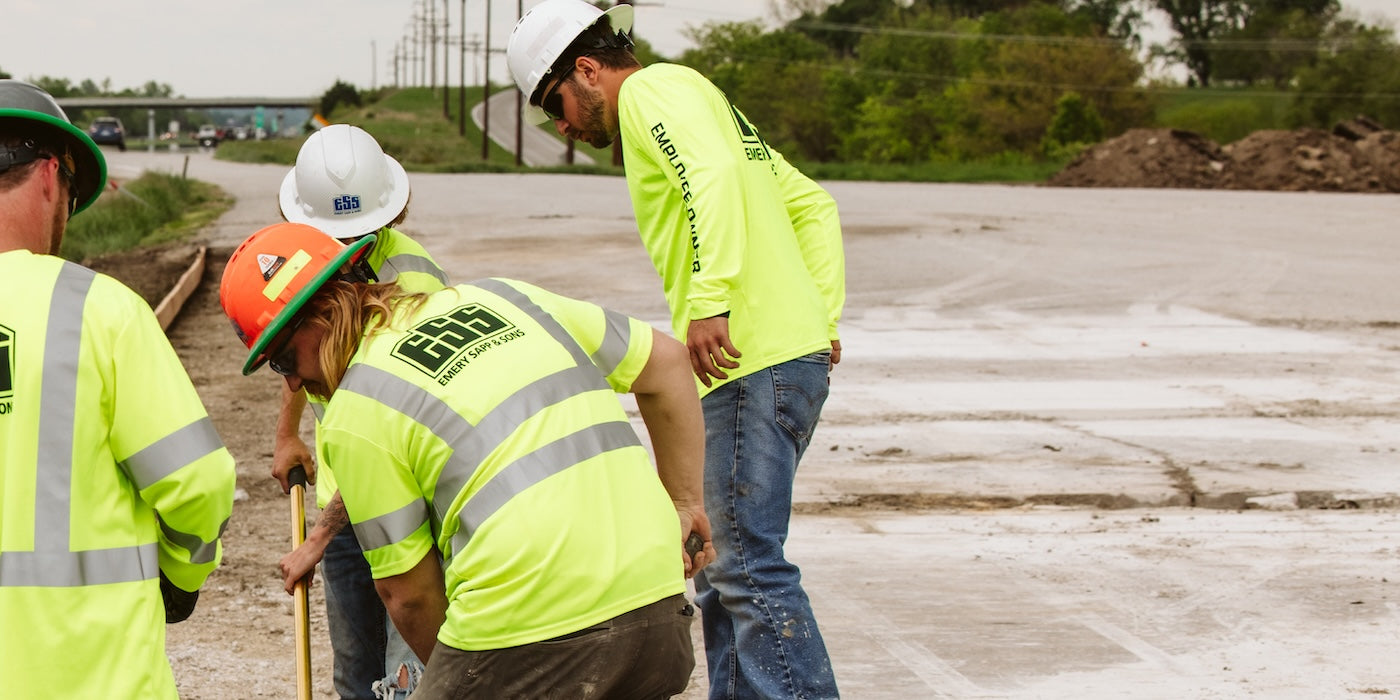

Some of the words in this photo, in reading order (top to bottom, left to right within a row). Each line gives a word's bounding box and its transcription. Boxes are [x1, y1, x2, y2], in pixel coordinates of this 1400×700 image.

[397, 304, 509, 374] ESS
[437, 356, 470, 387] EMERY
[468, 342, 492, 359] SAPP
[491, 339, 502, 347] &
[499, 328, 526, 343] SONS
